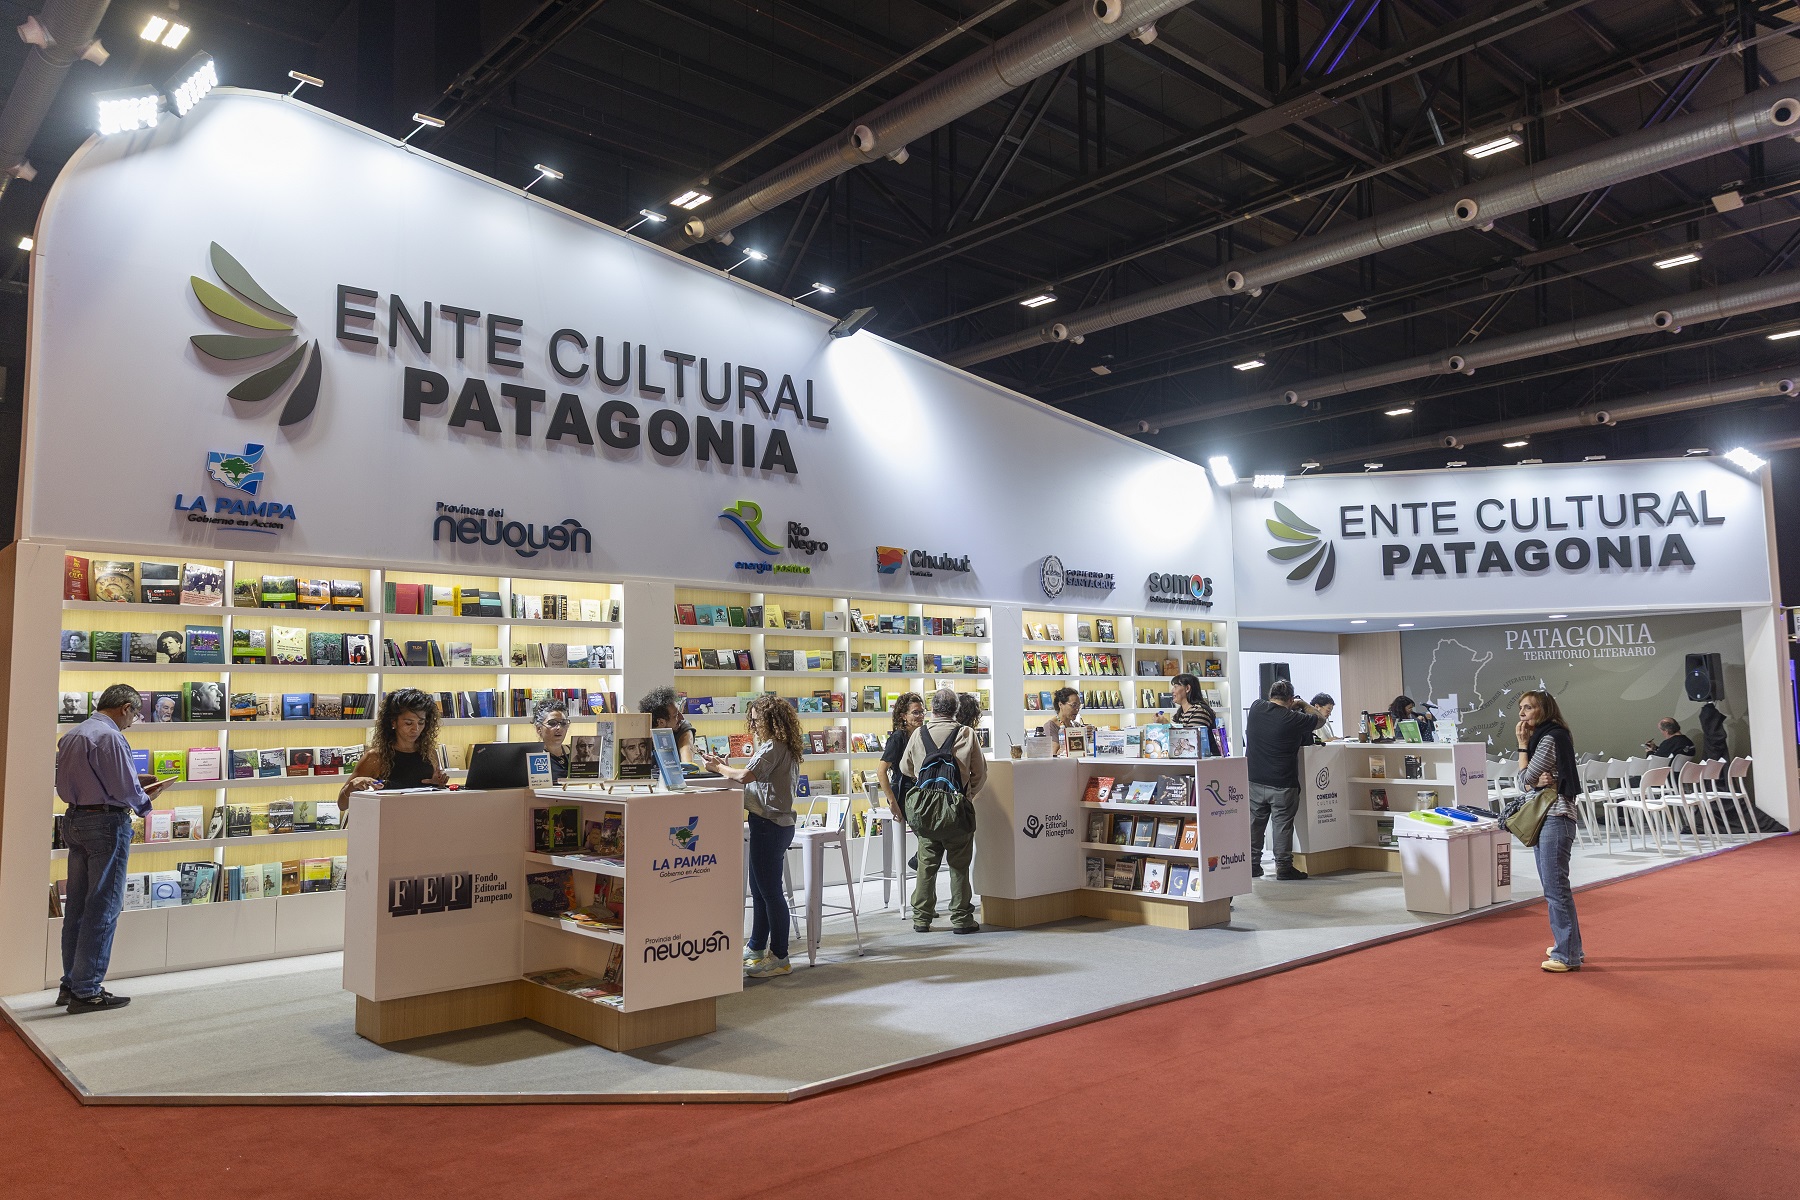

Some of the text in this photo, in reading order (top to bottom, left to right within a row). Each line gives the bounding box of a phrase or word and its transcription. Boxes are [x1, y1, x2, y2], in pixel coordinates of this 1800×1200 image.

[336, 284, 829, 424] ENTE CULTURAL
[402, 366, 798, 474] PATAGONIA
[174, 493, 297, 521] LA PAMPA
[436, 501, 504, 518] Provincia del
[1339, 489, 1726, 538] ENTE CULTURAL
[188, 513, 234, 526] Gobierno
[787, 520, 810, 537] Río
[787, 534, 829, 555] Negro
[909, 549, 971, 573] Chubut
[1382, 533, 1696, 577] PATAGONIA
[773, 563, 811, 575] positiva
[1066, 569, 1104, 578] GOBIERNO
[1505, 623, 1655, 651] PATAGONIA
[1523, 646, 1656, 662] TERRITORIO LITERARIO
[1503, 675, 1536, 689] LITERATURA
[157, 759, 180, 769] ABC
[1228, 792, 1244, 802] Negro
[1316, 792, 1338, 800] CONEXIÓN
[1045, 813, 1062, 822] Fondo
[1045, 820, 1068, 830] Editorial
[1045, 828, 1075, 838] Rionegrino
[652, 853, 717, 871] LA PAMPA
[1220, 852, 1246, 865] Chubut
[474, 872, 498, 883] Fondo
[659, 869, 684, 878] Gobierno
[693, 866, 711, 875] Acción
[392, 874, 463, 908] FEP
[474, 881, 507, 893] Editorial
[474, 893, 513, 904] Pampeano
[645, 933, 682, 945] Provincia del
